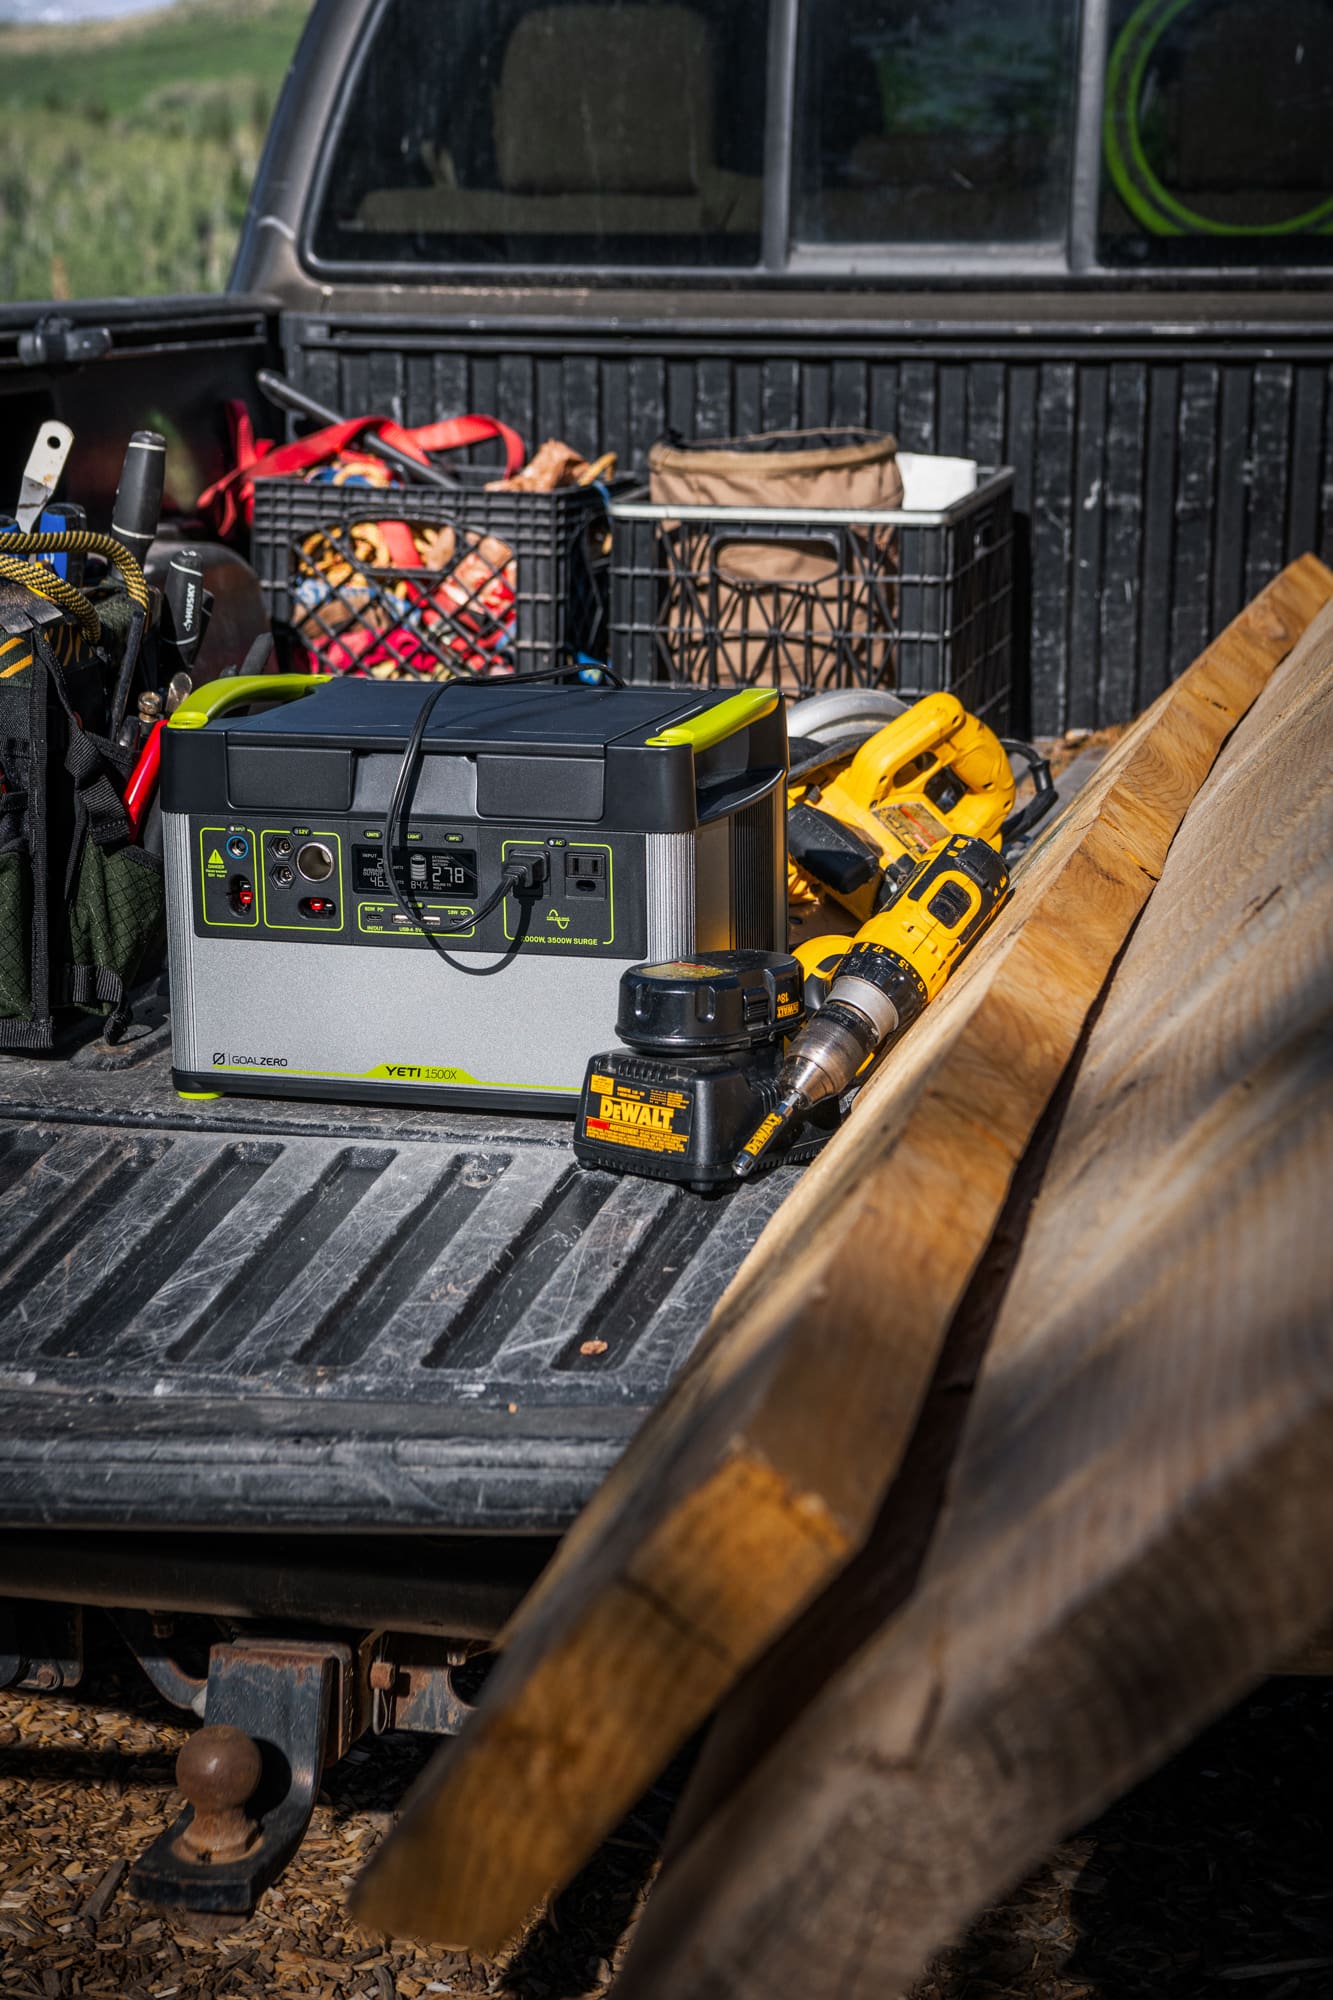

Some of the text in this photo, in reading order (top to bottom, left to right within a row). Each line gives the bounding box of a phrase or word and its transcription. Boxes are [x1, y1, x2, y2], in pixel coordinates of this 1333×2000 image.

[185, 582, 196, 620] HUSKY
[432, 867, 465, 883] 278
[547, 937, 572, 945] 3500W
[573, 938, 598, 946] SURGE
[231, 1054, 288, 1067] GOALZERO
[385, 1066, 458, 1080] YETI 1500X
